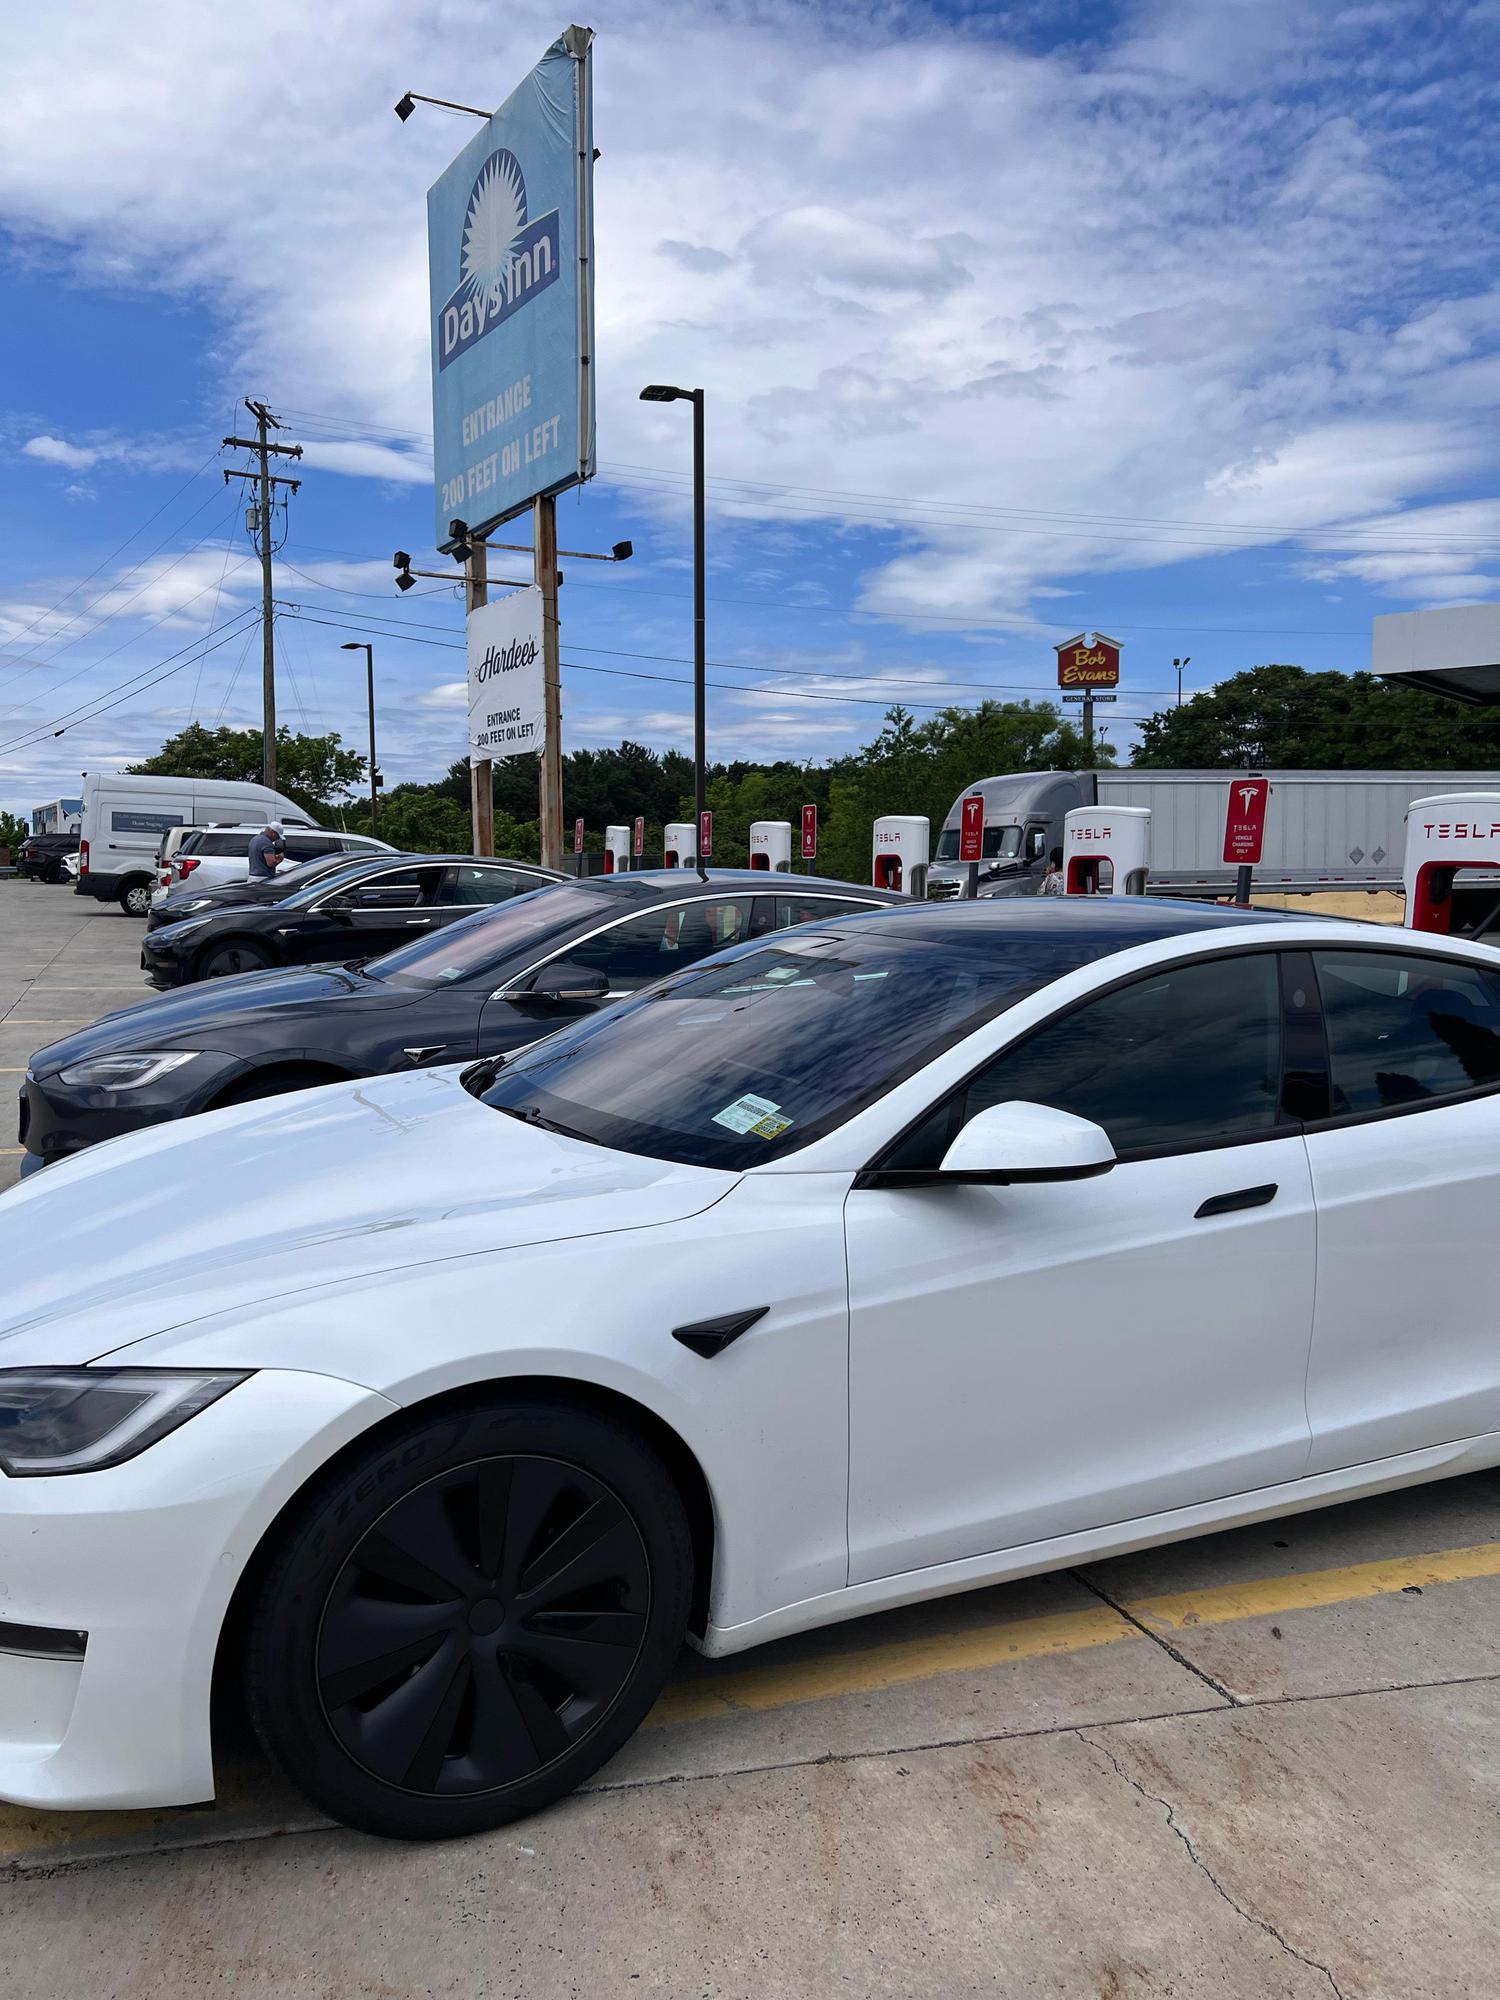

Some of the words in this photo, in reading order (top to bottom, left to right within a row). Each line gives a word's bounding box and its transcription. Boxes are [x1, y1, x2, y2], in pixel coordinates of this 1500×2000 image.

[444, 279, 503, 356] Days
[462, 374, 532, 448] ENTRANCE
[442, 474, 465, 513] 200
[467, 452, 498, 497] FEET
[502, 439, 520, 477] ON
[524, 414, 561, 465] LEFT
[478, 634, 540, 684] Hardee's
[1073, 649, 1107, 666] Bob
[1062, 666, 1117, 683] Evans
[487, 707, 521, 727] ENTRANCE
[477, 732, 489, 747] 200
[490, 729, 506, 744] FEET
[506, 727, 517, 741] ON
[517, 723, 534, 739] LEFT
[875, 832, 901, 843] TESLA
[1070, 827, 1112, 840] TESLA
[1233, 824, 1257, 832] TESLA
